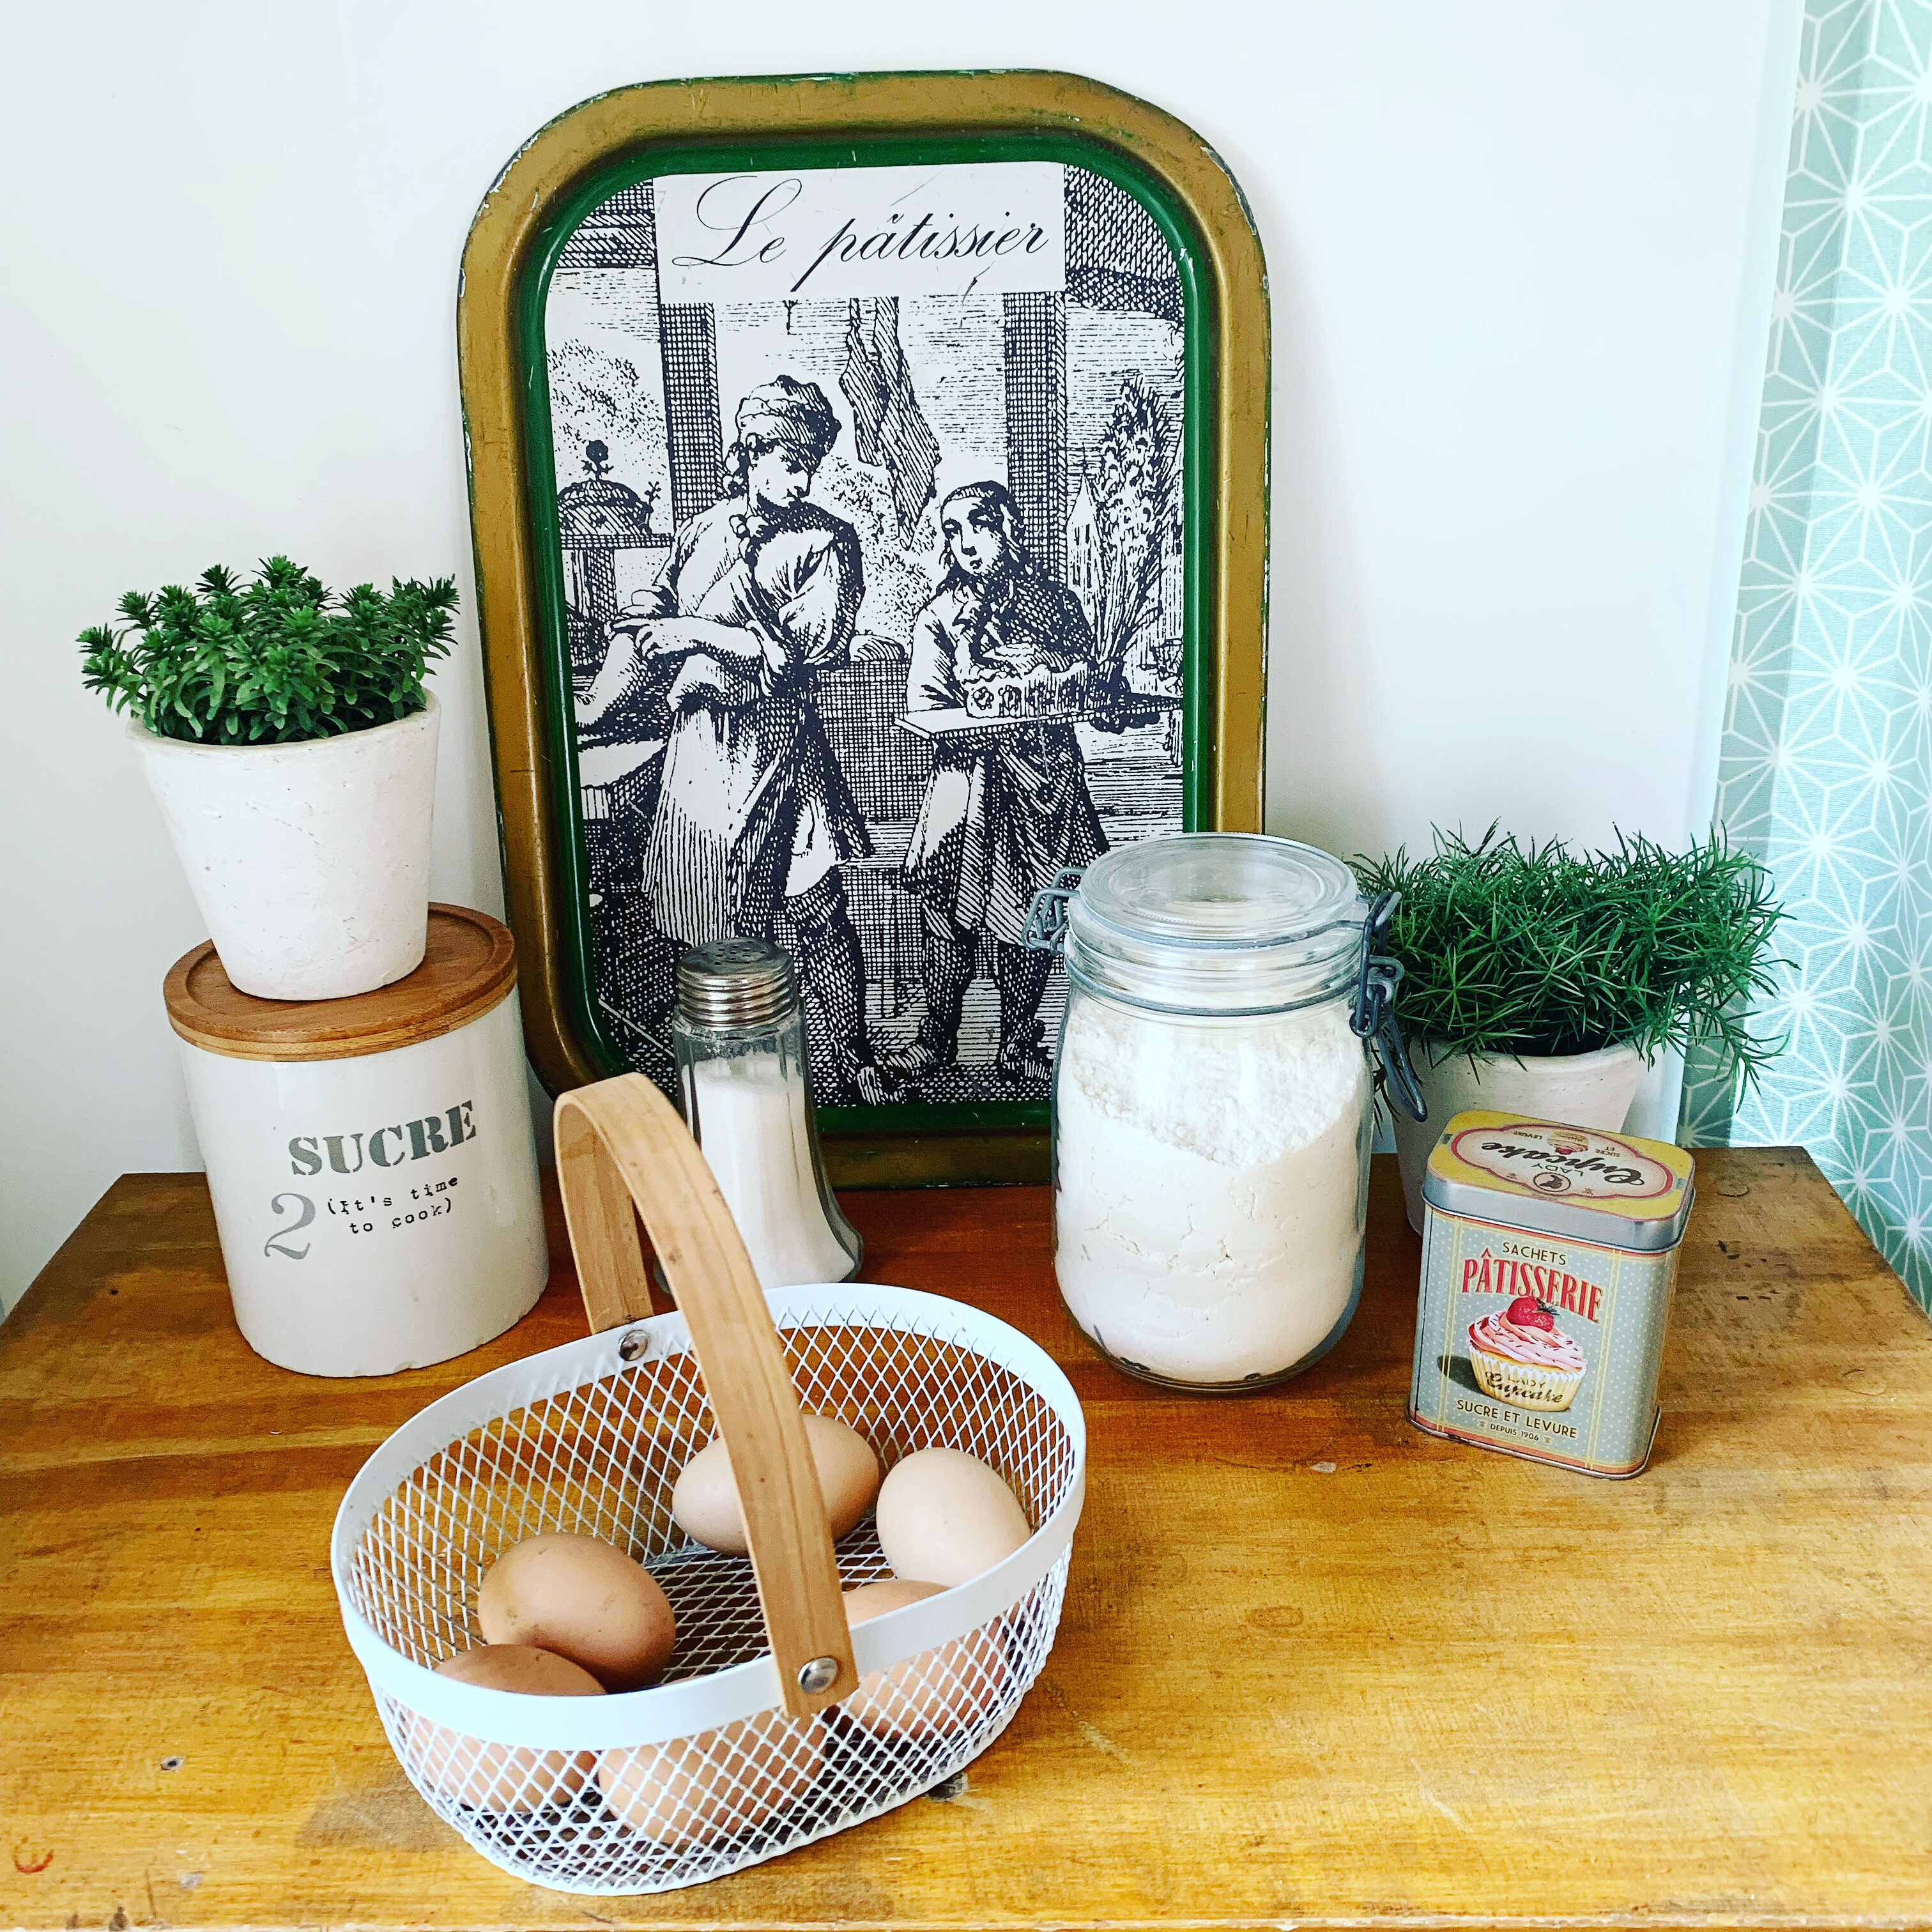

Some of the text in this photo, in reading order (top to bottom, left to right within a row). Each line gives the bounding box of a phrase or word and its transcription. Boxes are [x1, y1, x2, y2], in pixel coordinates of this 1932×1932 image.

[672, 176, 1050, 293] Le pâtissier
[288, 1100, 477, 1176] SUCRE
[1481, 1142, 1645, 1186] Cupcake
[1531, 1163, 1584, 1177] LADY
[410, 1176, 458, 1200] time
[264, 1192, 316, 1260] 2
[349, 1197, 452, 1234] to cook)
[1502, 1241, 1567, 1266] SACHETS
[1462, 1248, 1604, 1324] PÂTISSERIE
[1485, 1371, 1564, 1404] Cupcake
[1507, 1374, 1547, 1389] LADY
[1457, 1399, 1577, 1438] SUCRE ET LEVURE
[1490, 1423, 1540, 1441] DEPUIS 1906
